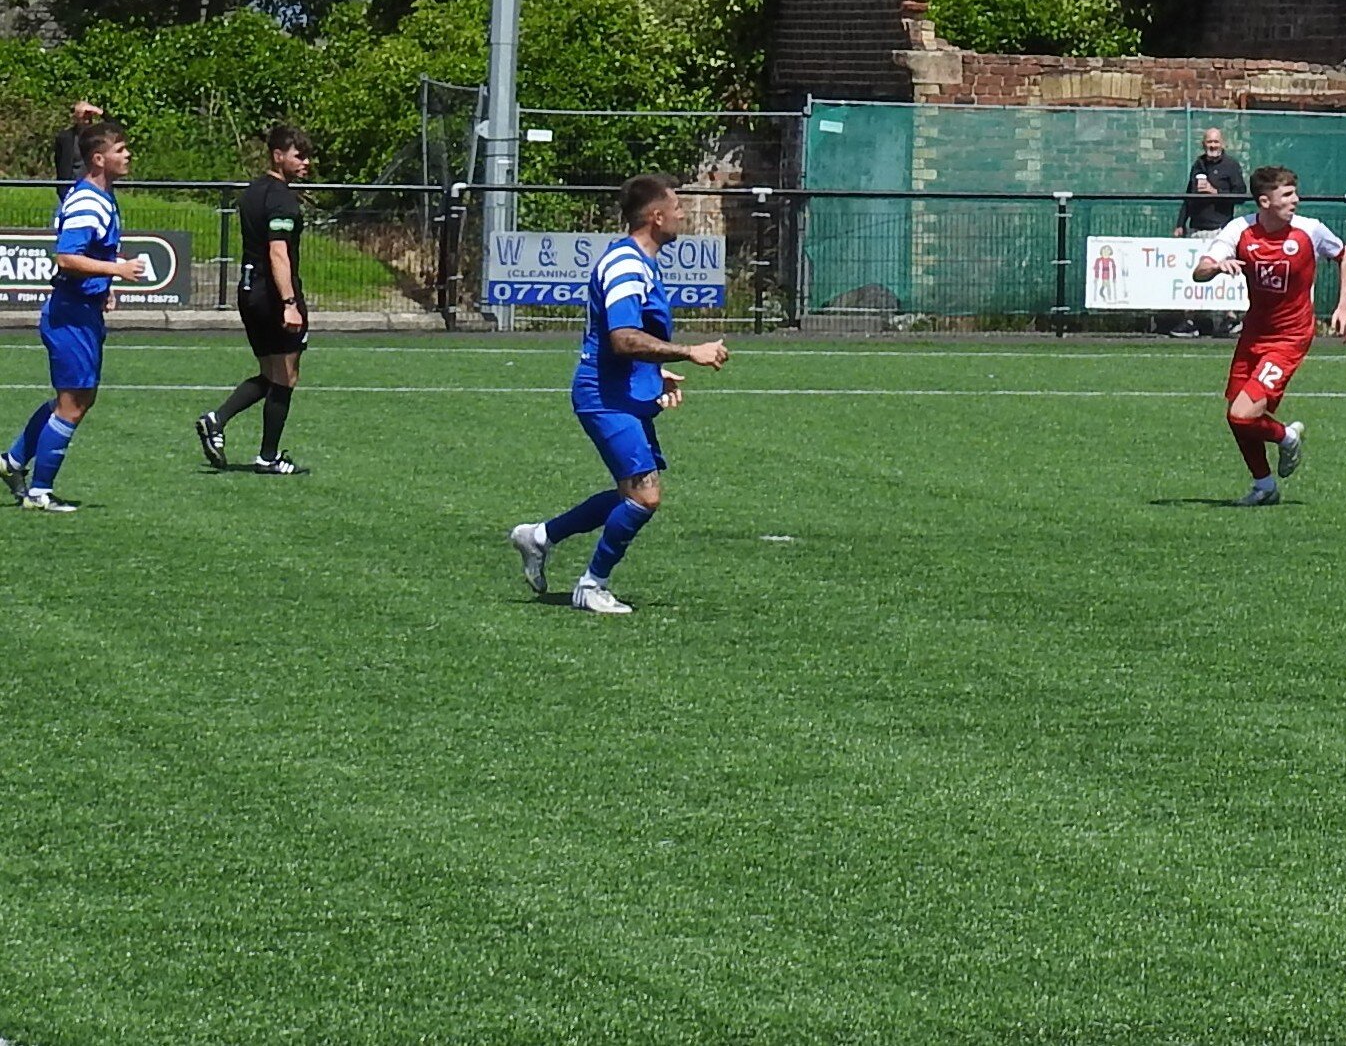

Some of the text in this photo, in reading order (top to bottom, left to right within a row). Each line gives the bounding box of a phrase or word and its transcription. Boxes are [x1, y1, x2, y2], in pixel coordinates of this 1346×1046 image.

[496, 236, 524, 266] W
[538, 235, 558, 267] &
[1142, 248, 1176, 268] The
[685, 273, 708, 281] LTD
[1172, 279, 1244, 301] Foundat
[1258, 361, 1283, 389] 12
